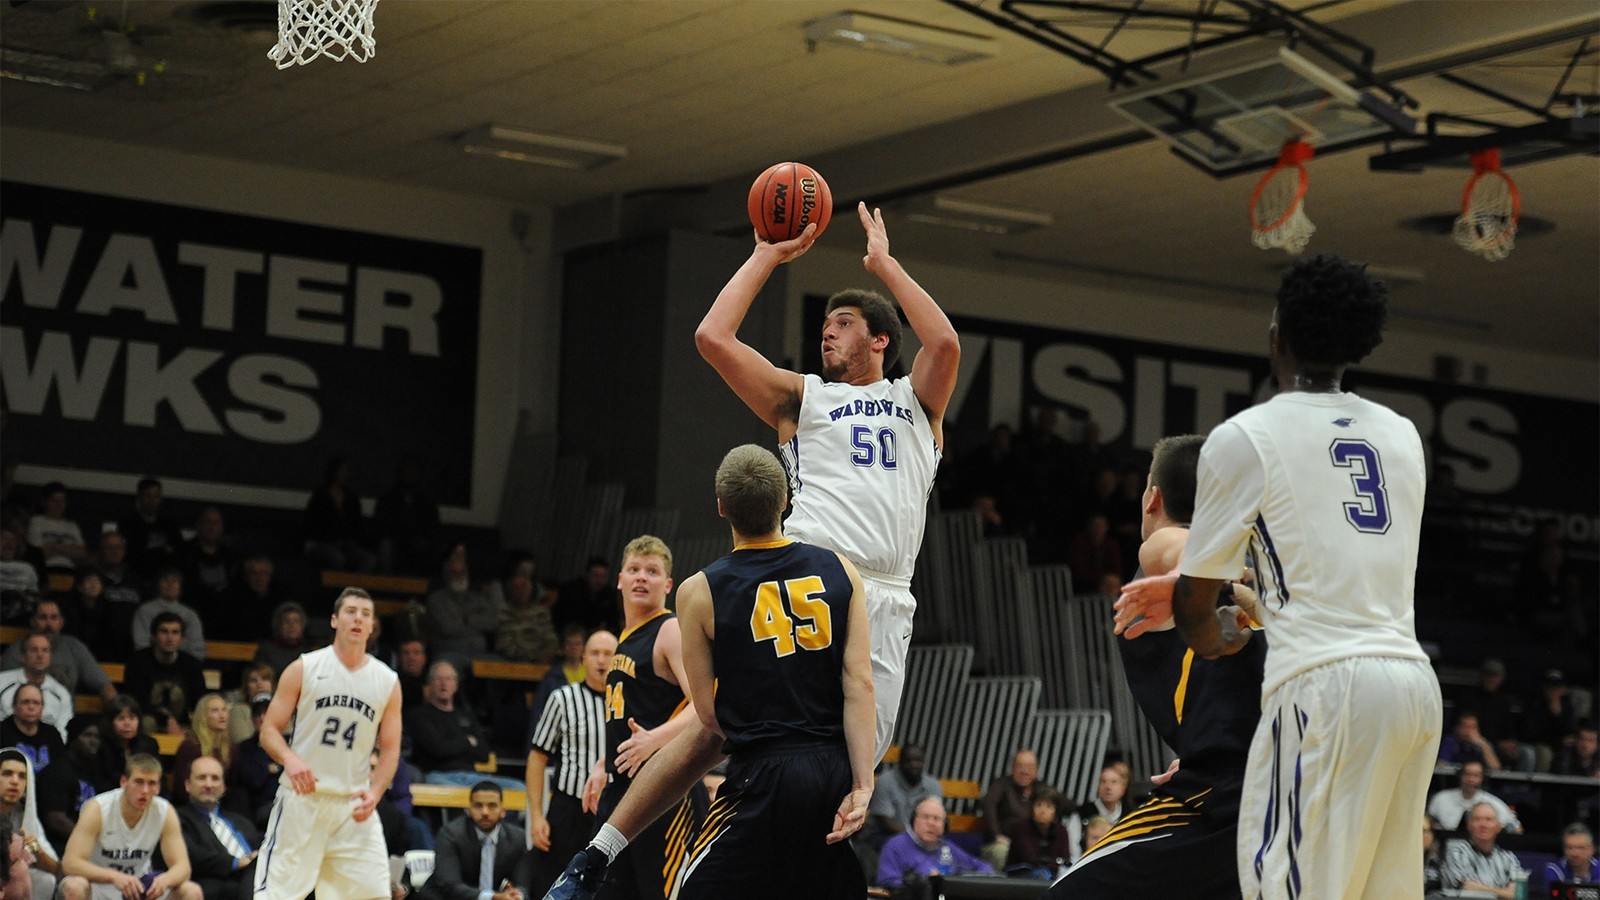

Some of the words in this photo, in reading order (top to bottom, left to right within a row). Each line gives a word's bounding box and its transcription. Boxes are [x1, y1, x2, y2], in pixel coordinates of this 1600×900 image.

[773, 183, 788, 224] NCAA
[0, 217, 444, 358] WATER
[829, 398, 914, 427] WARHAWKS
[903, 321, 1523, 496] VISITS
[850, 424, 897, 471] 50
[1328, 437, 1393, 535] 3
[750, 575, 832, 659] 45
[316, 695, 375, 721] WARHAWKS
[321, 716, 358, 750] 24
